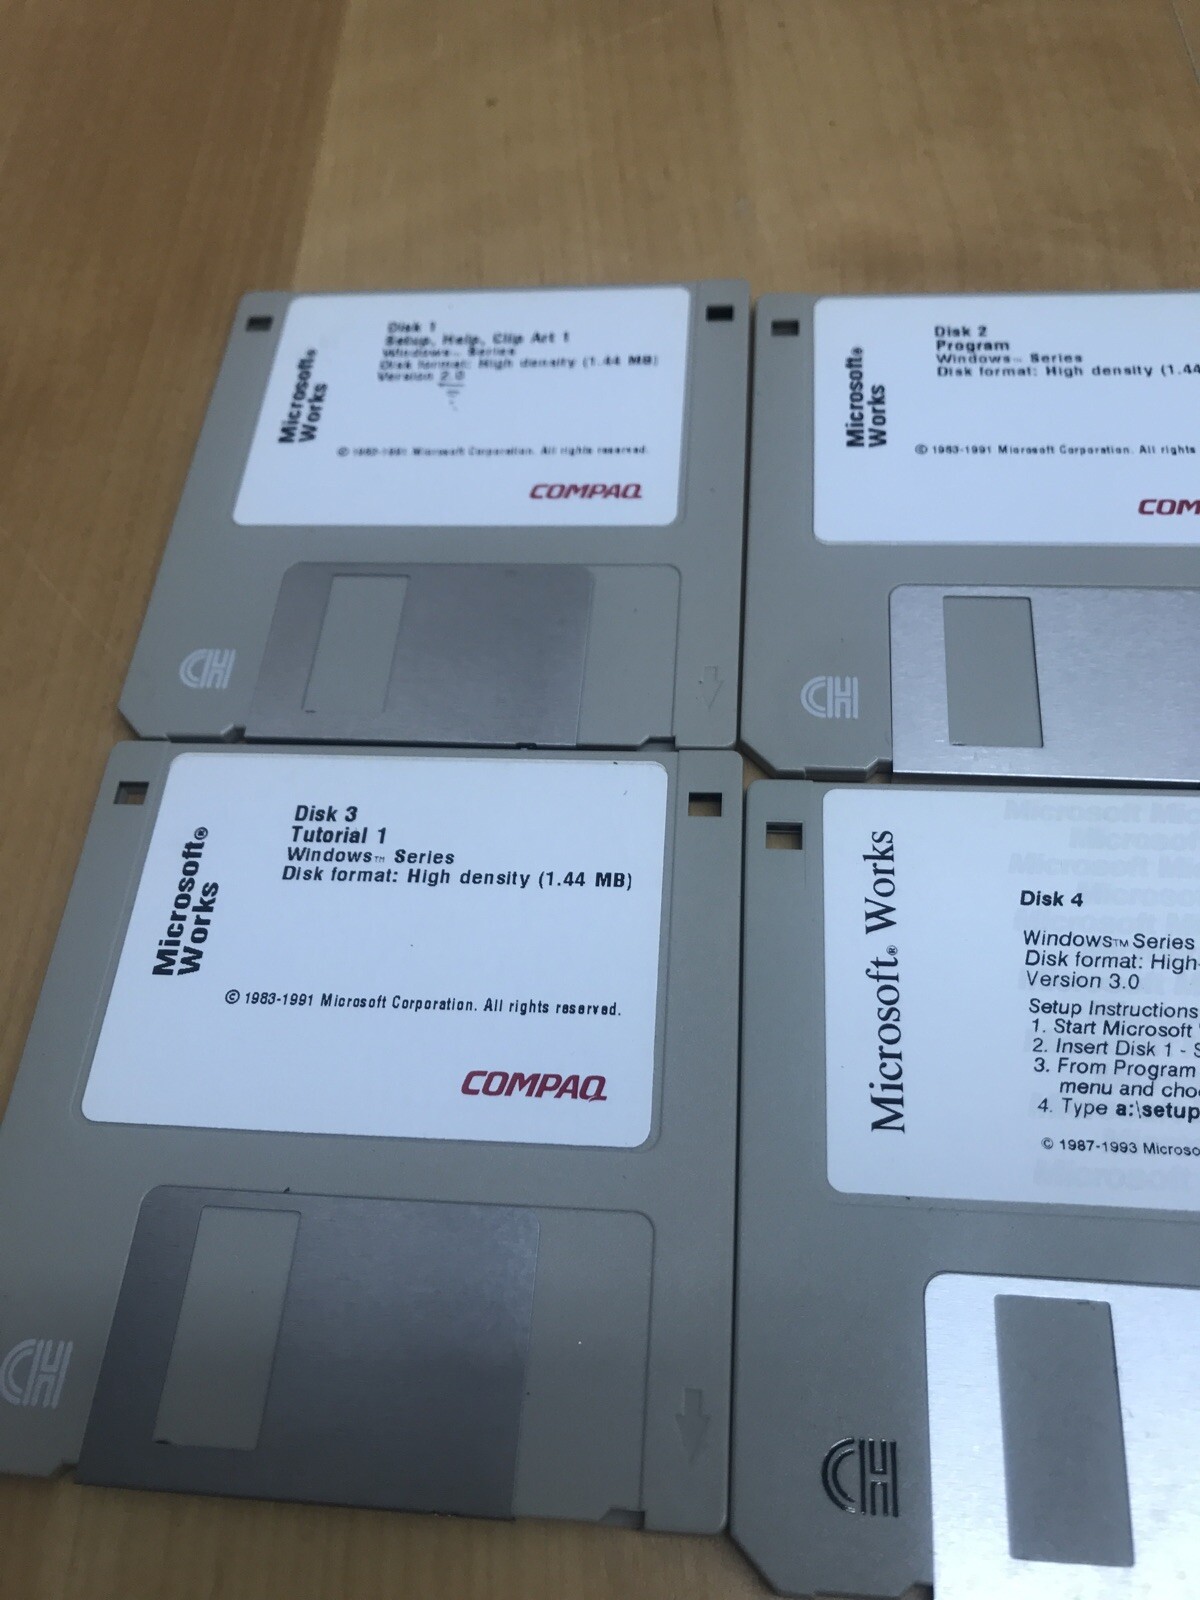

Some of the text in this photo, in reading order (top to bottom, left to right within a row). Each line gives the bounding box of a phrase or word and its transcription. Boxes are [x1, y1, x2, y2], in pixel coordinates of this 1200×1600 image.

[387, 321, 436, 333] Disk 1
[934, 326, 988, 337] Disk 2
[492, 332, 524, 346] Clip
[531, 331, 555, 344] Art
[563, 331, 570, 344] 1
[936, 340, 1010, 353] Program
[379, 360, 411, 370] Disk
[478, 358, 513, 371] High
[520, 357, 575, 369] density
[627, 355, 659, 367] MB)
[1030, 353, 1083, 364] Series
[937, 364, 1200, 378] Disk format: High density (1.44
[298, 383, 328, 443] Works
[866, 384, 887, 448] Works
[540, 445, 557, 455] All
[560, 445, 592, 457] rights
[932, 445, 992, 455] 1983-1991
[998, 444, 1055, 455] Microsoft
[1139, 444, 1156, 455] All
[1161, 445, 1196, 456] rights
[529, 482, 643, 499] COMPAQ
[294, 804, 359, 823] Disk 3
[291, 825, 387, 845] Tutorial 1
[393, 849, 455, 865] Series
[281, 865, 633, 891] Disk format: High density (1.44 MB)
[863, 830, 897, 934] Works
[1020, 890, 1084, 907] Disk 4
[177, 882, 220, 976] Works
[1132, 933, 1195, 950] Series
[1025, 949, 1069, 966] Disk
[1075, 951, 1143, 969] format:
[1026, 970, 1140, 989] Version 3.0
[224, 989, 622, 1017] © 1983-1991 Microsoft Corporation. All rights reserved.
[1028, 998, 1199, 1019] Setup Instructions
[1032, 1018, 1046, 1033] 1.
[1054, 1017, 1097, 1035] Start
[1102, 1019, 1193, 1038] Microsoft
[1032, 1037, 1048, 1052] 2.
[1056, 1037, 1109, 1055] Insert
[1115, 1040, 1156, 1057] Disk
[1164, 1042, 1171, 1057] 1
[1033, 1057, 1196, 1081] 3. From Program
[460, 1069, 608, 1103] COMPAQ
[1060, 1081, 1200, 1098] menu and cho
[1037, 1097, 1200, 1123] 4. Type a:\setup
[1059, 1139, 1138, 1154] 1987-1993
[1143, 1142, 1200, 1156] Microso
